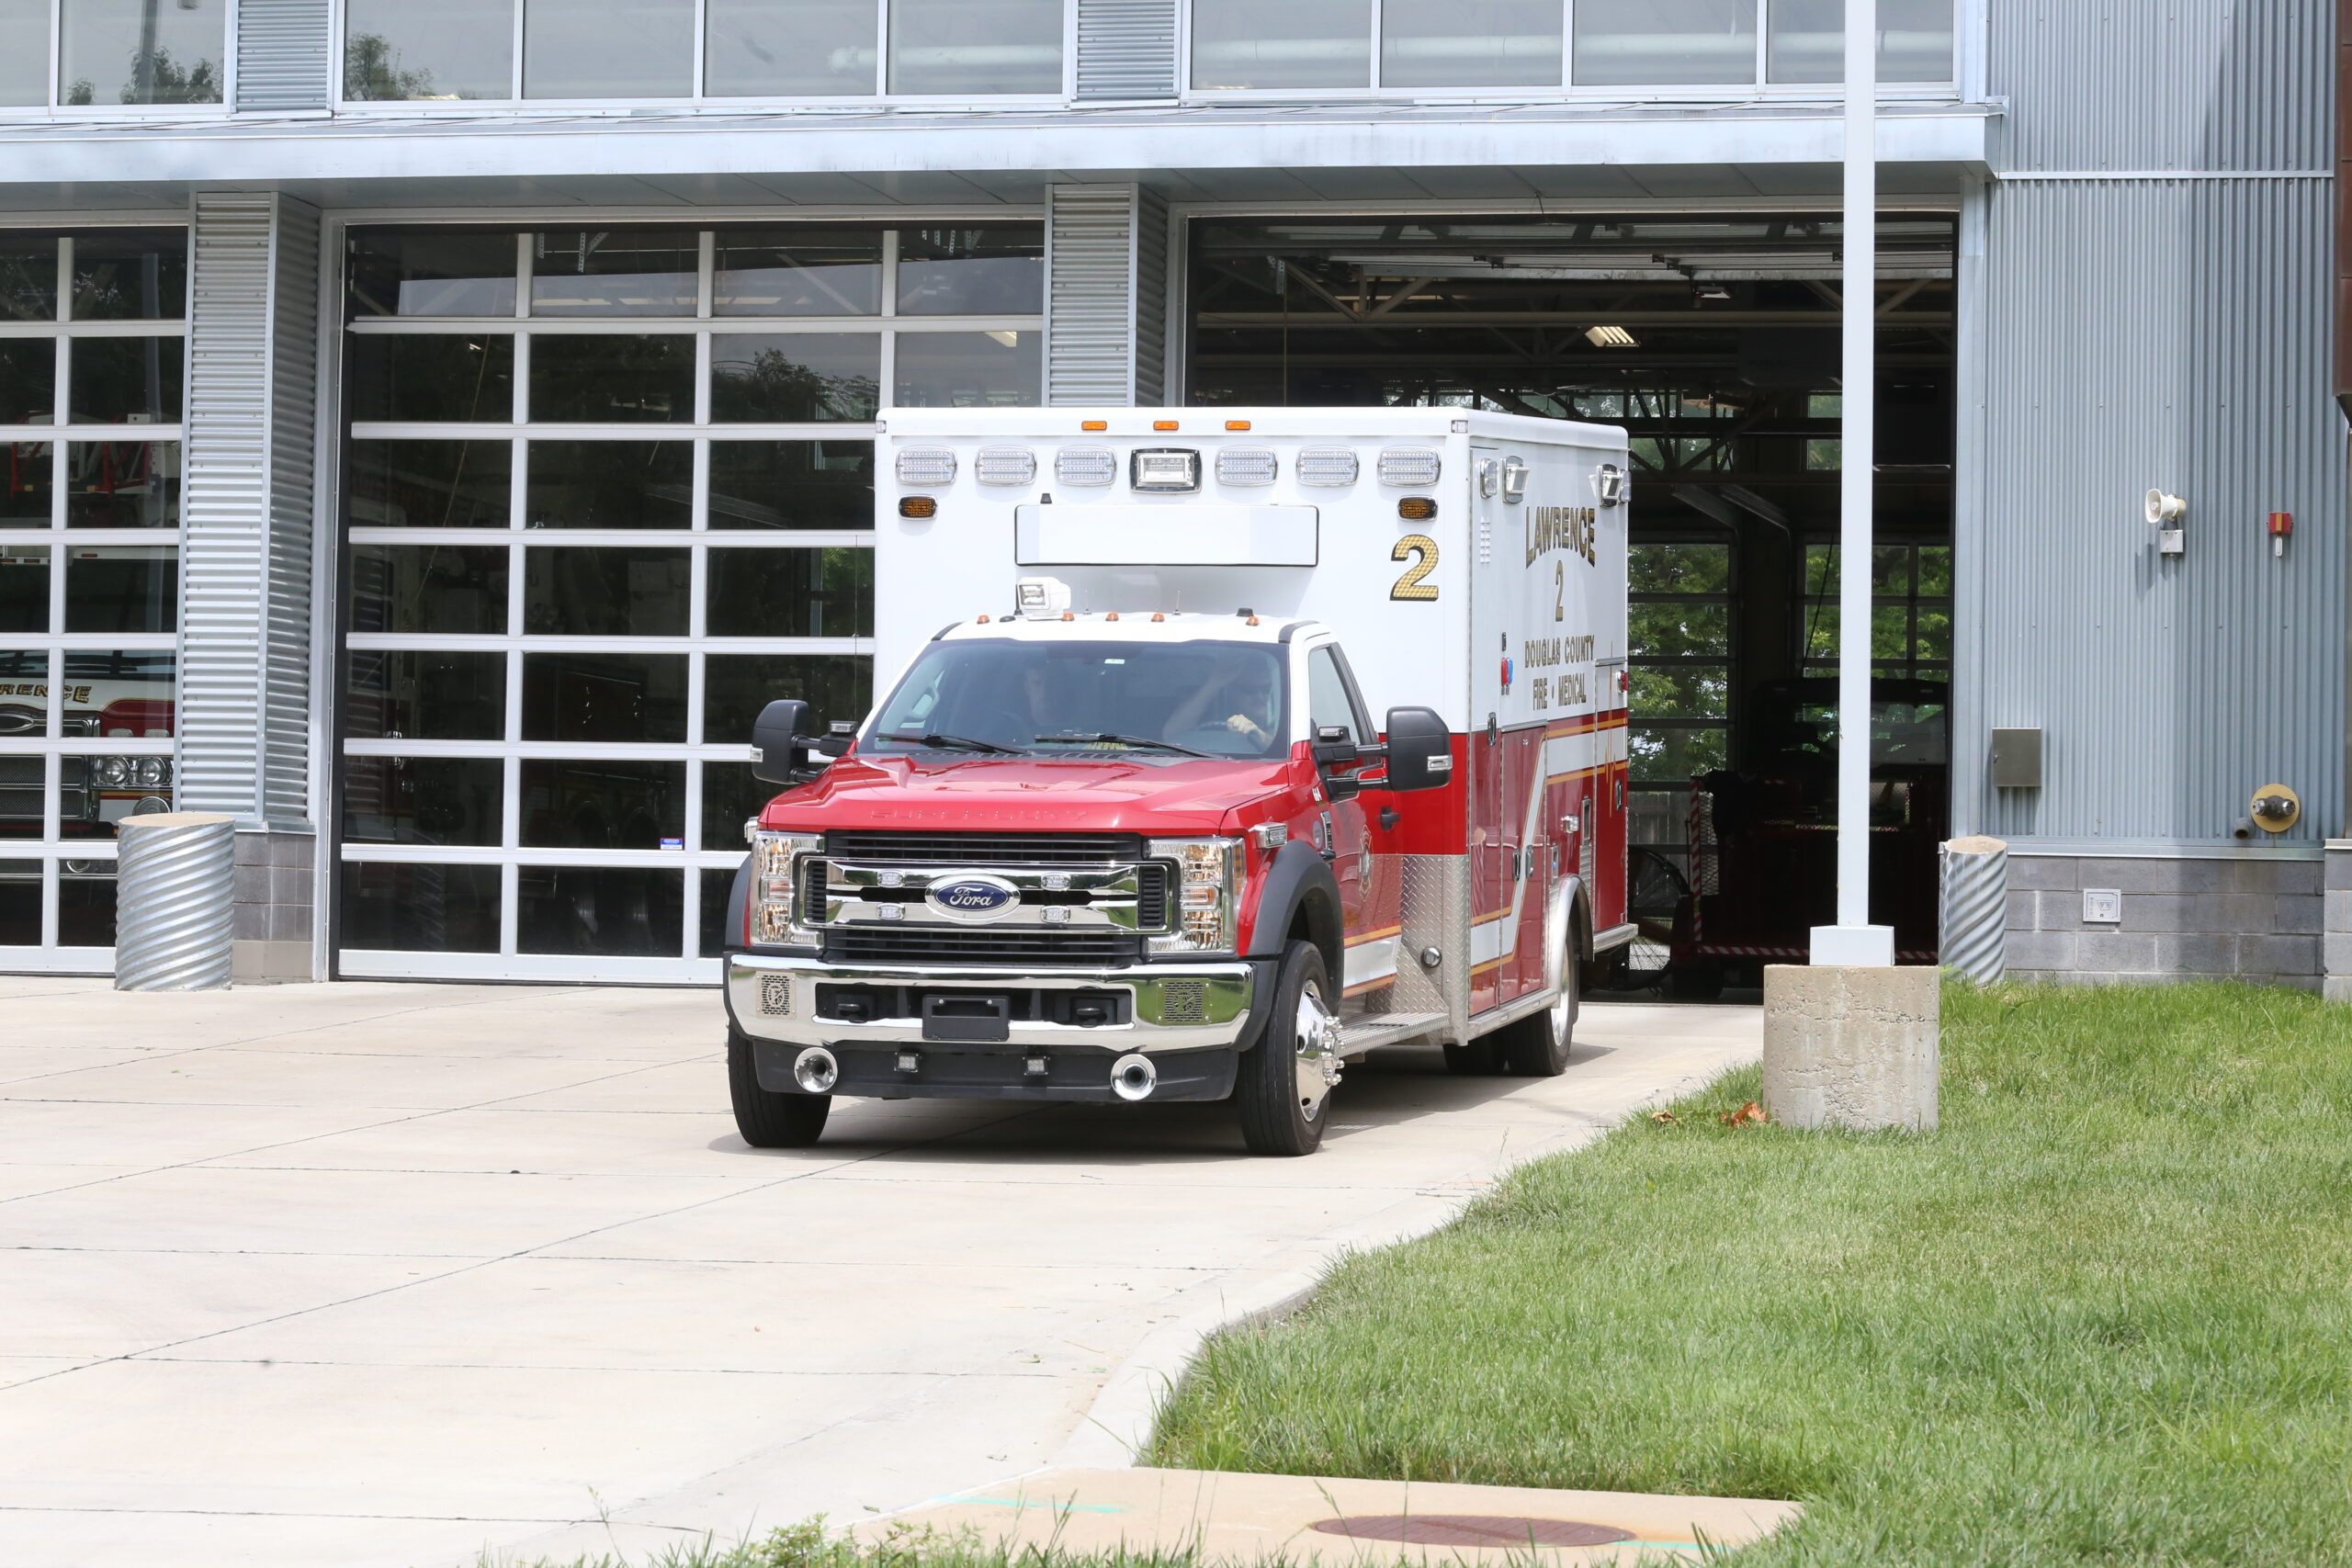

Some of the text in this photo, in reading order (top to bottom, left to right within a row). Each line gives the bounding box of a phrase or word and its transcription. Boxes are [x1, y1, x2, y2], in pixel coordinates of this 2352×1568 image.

[1525, 506, 1595, 569] LAWRENCE
[1389, 534, 1439, 602] 2
[1555, 559, 1564, 622] 2
[1524, 635, 1595, 669] DOUGLAS COUNTY
[1532, 673, 1587, 710] FIRE MEDICAL
[949, 886, 993, 906] Ford
